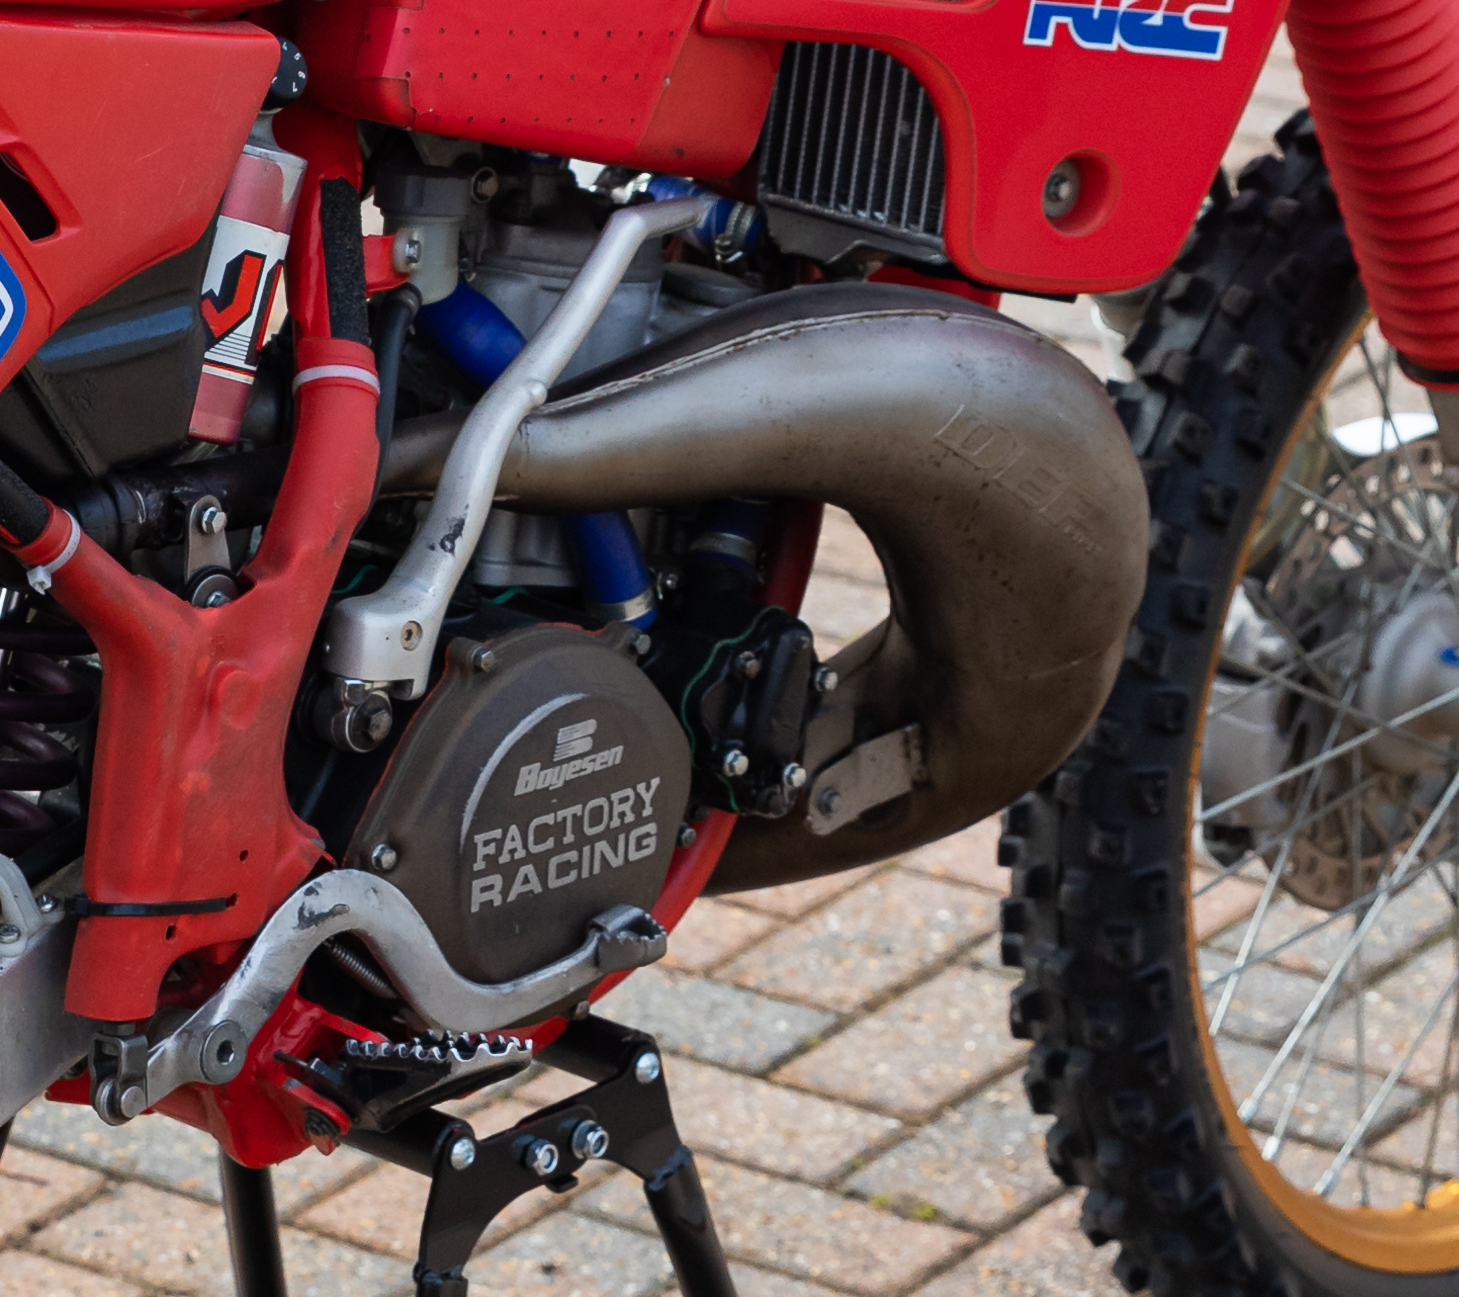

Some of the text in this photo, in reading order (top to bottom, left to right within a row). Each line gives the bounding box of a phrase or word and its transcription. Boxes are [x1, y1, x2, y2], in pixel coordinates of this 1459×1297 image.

[514, 745, 624, 796] Boyesen
[470, 822, 658, 914] RACING
[473, 776, 661, 872] FACTORY
